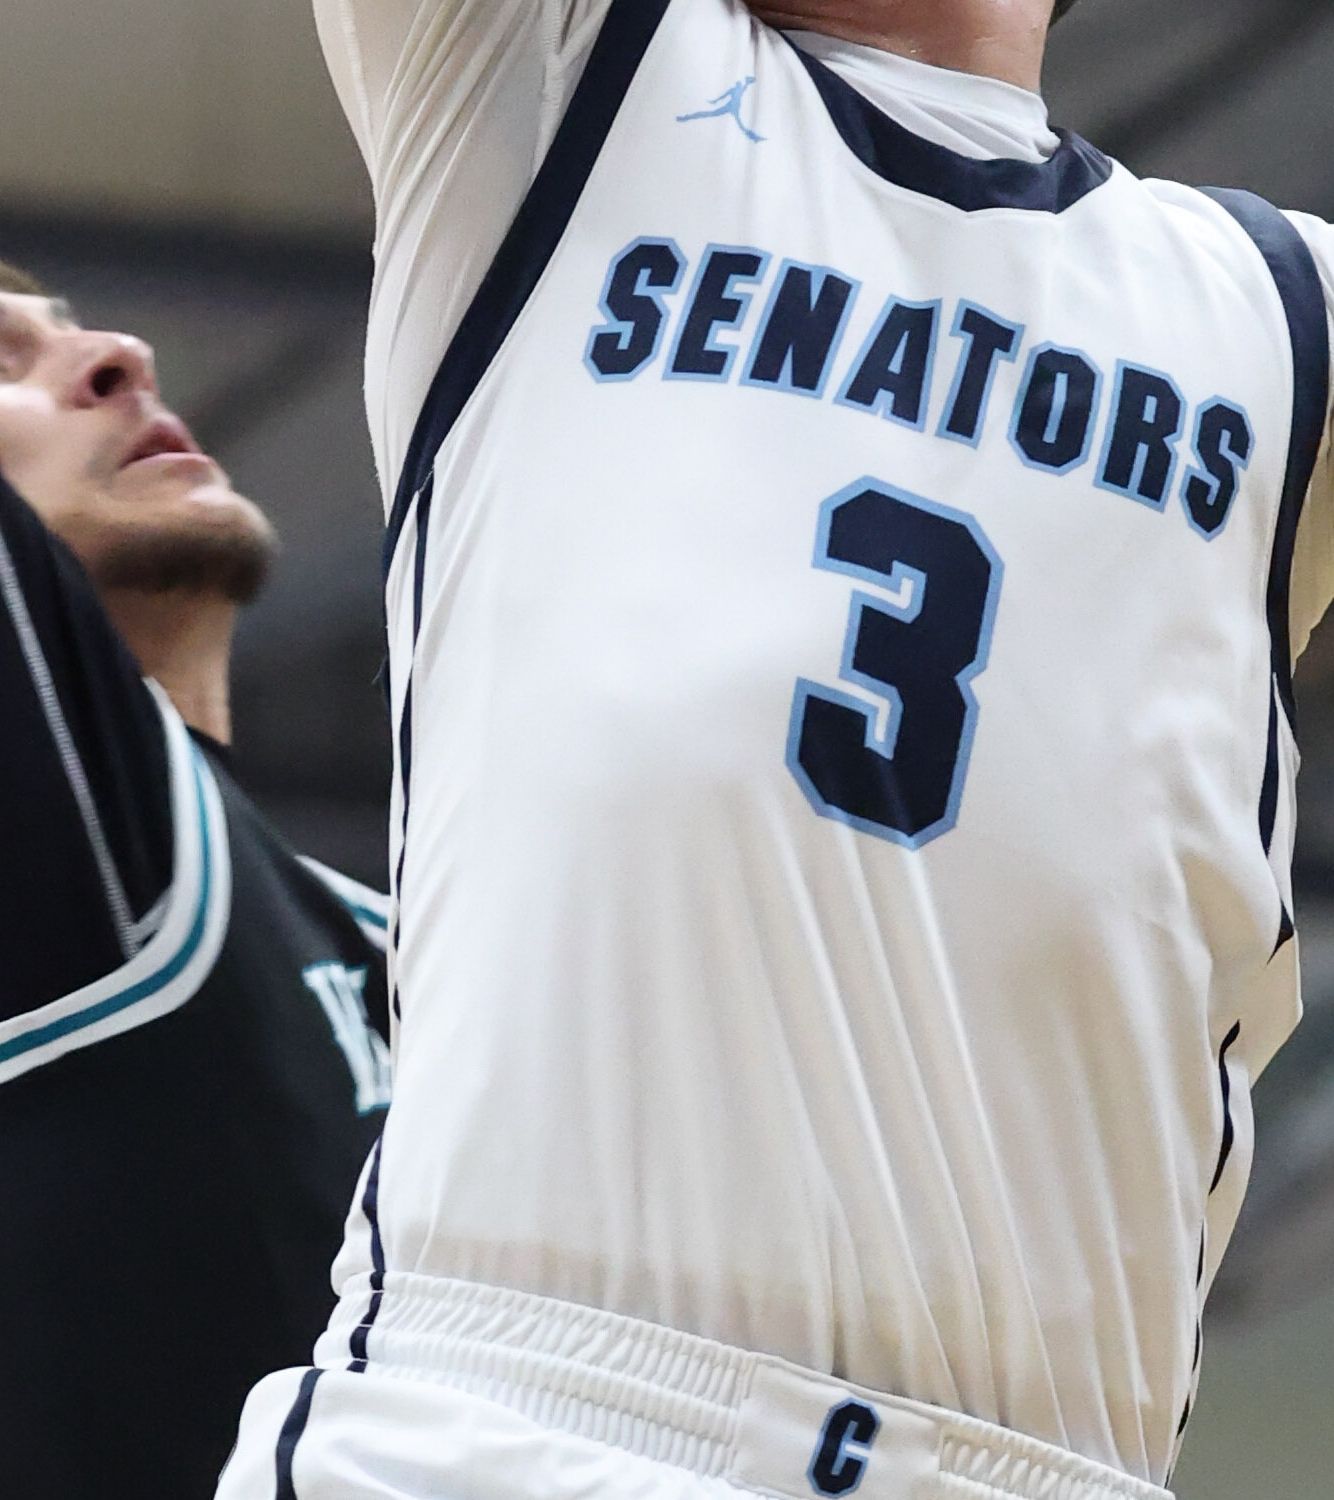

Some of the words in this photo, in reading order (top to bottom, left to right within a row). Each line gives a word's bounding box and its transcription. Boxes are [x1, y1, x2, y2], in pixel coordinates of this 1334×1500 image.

[583, 235, 1255, 542] SENATORS
[785, 475, 1005, 852] 3
[806, 1397, 880, 1500] C
